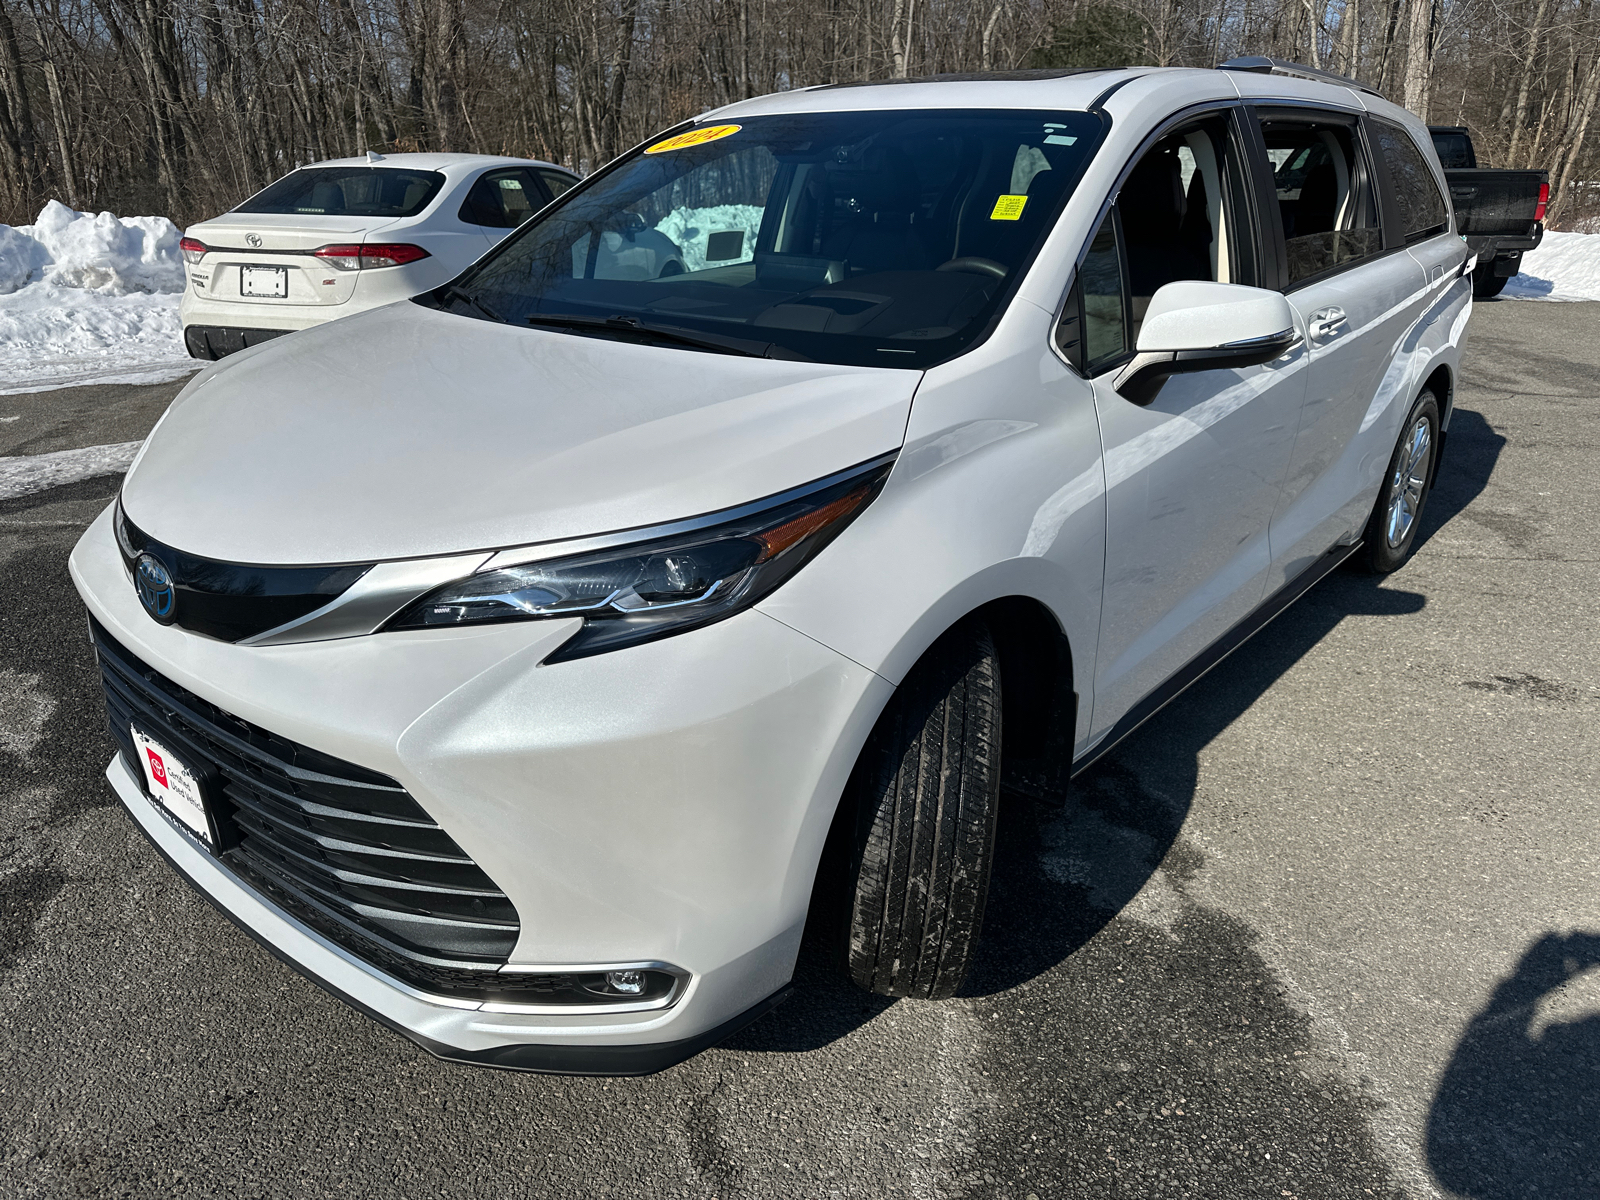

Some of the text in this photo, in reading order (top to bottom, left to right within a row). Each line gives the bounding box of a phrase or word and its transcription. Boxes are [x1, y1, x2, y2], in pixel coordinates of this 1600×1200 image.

[654, 127, 731, 151] 2024
[167, 766, 192, 792] Certified
[170, 780, 185, 798] Used
